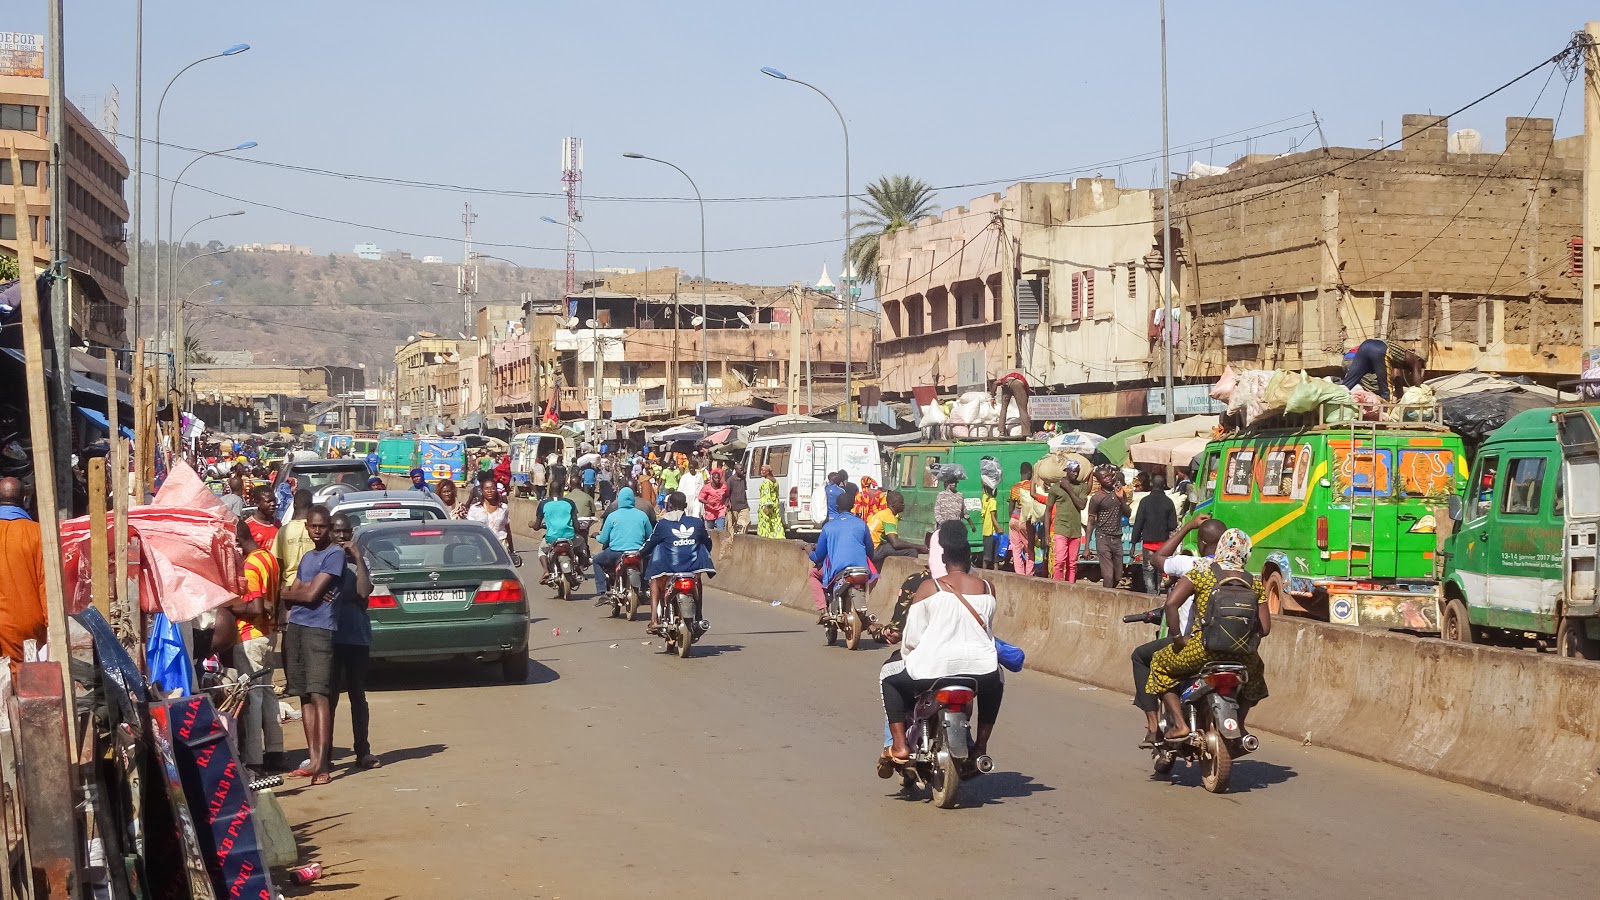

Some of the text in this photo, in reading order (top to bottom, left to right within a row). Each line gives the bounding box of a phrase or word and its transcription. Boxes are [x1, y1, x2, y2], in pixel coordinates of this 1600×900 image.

[673, 539, 695, 547] adidas
[1501, 552, 1517, 560] 13-14
[1519, 553, 1536, 561] janvier
[406, 589, 464, 602] AX 1882 MD
[179, 695, 203, 739] RALK
[230, 860, 255, 897] PNEU
